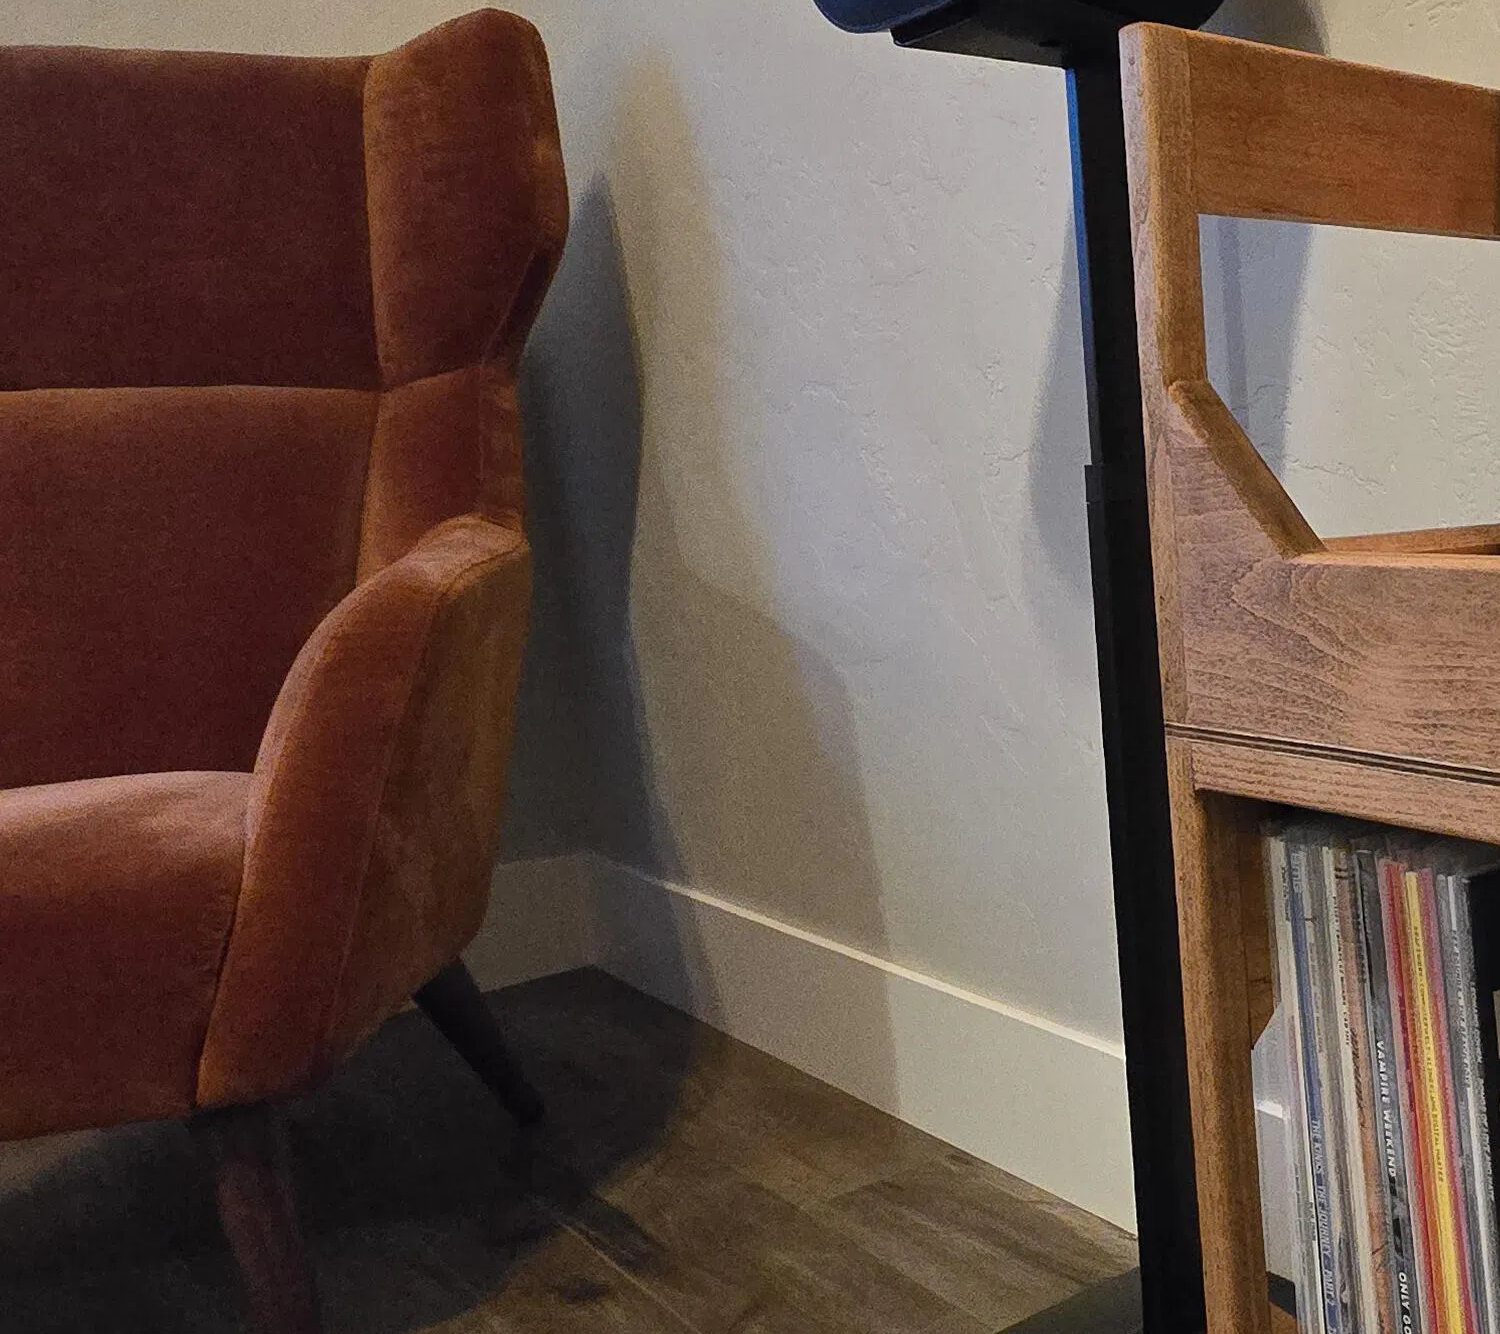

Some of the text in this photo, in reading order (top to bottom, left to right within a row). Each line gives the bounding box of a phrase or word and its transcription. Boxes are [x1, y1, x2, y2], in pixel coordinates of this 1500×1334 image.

[1376, 1040, 1391, 1107] VAMPIRE
[1381, 1111, 1397, 1178] WEEKEND
[1398, 1272, 1409, 1310] ONLY
